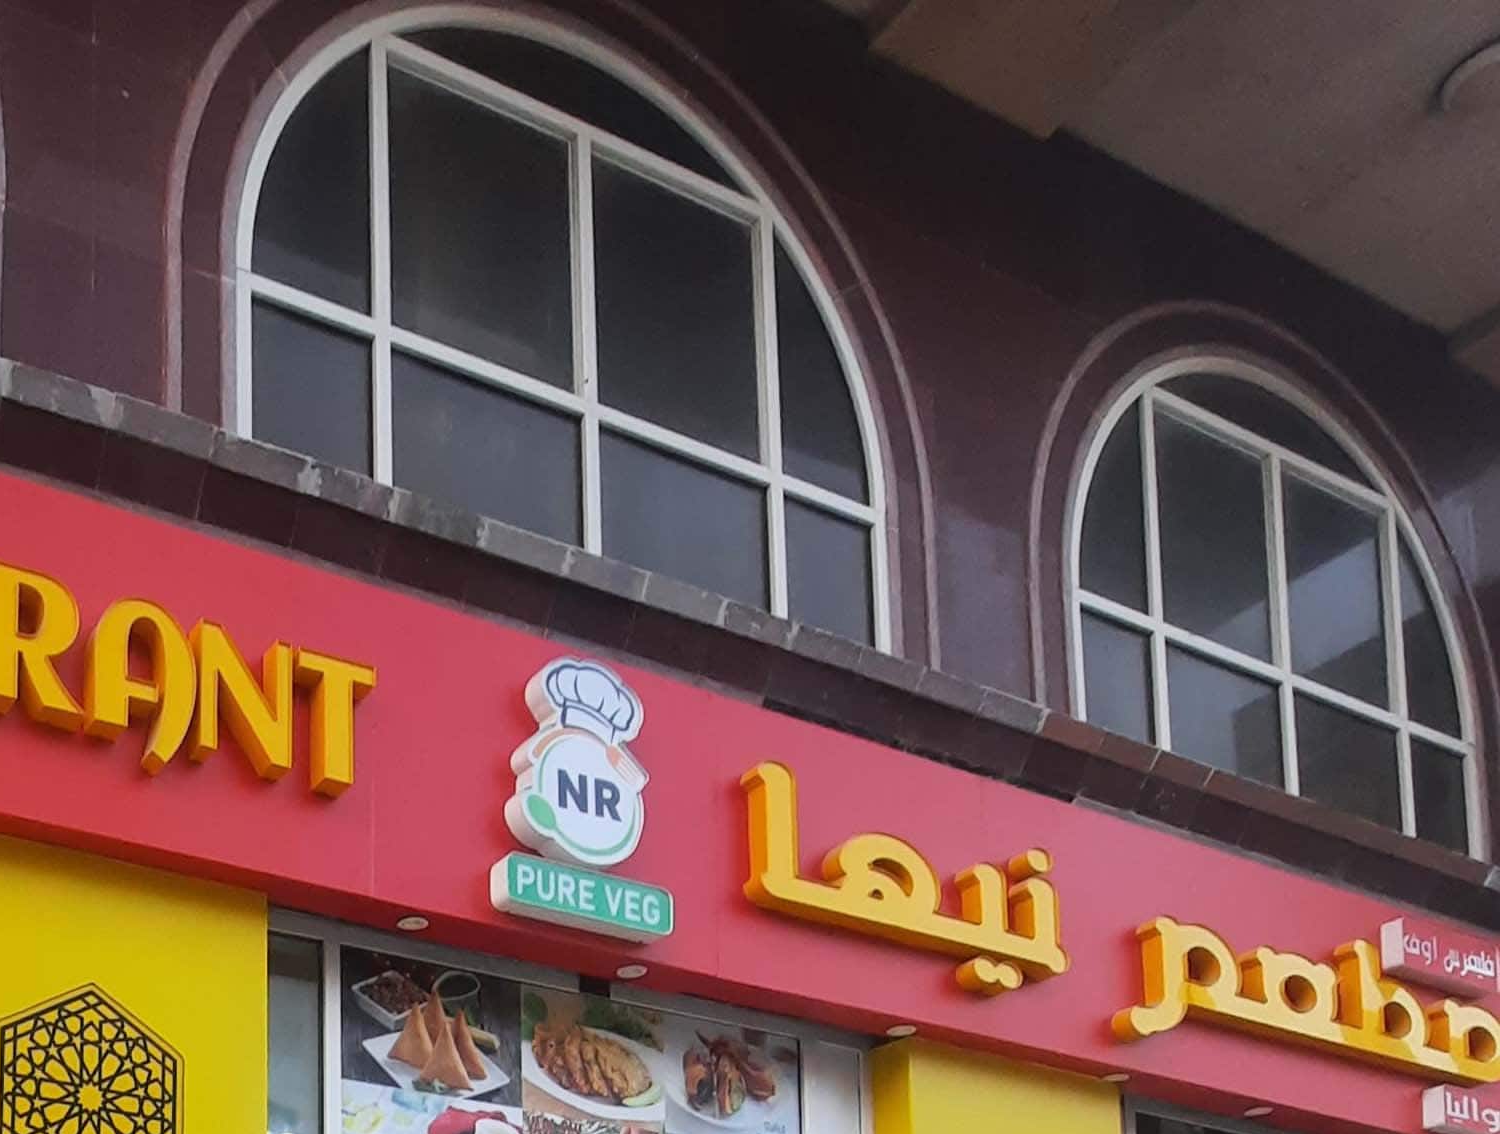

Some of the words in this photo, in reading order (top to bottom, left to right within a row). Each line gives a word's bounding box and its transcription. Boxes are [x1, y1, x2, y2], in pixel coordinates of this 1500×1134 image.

[557, 768, 622, 823] NR
[516, 863, 596, 911] PURE
[604, 884, 661, 925] VEG
[742, 760, 1072, 992] نيها
[1112, 916, 1500, 1083] مطعم
